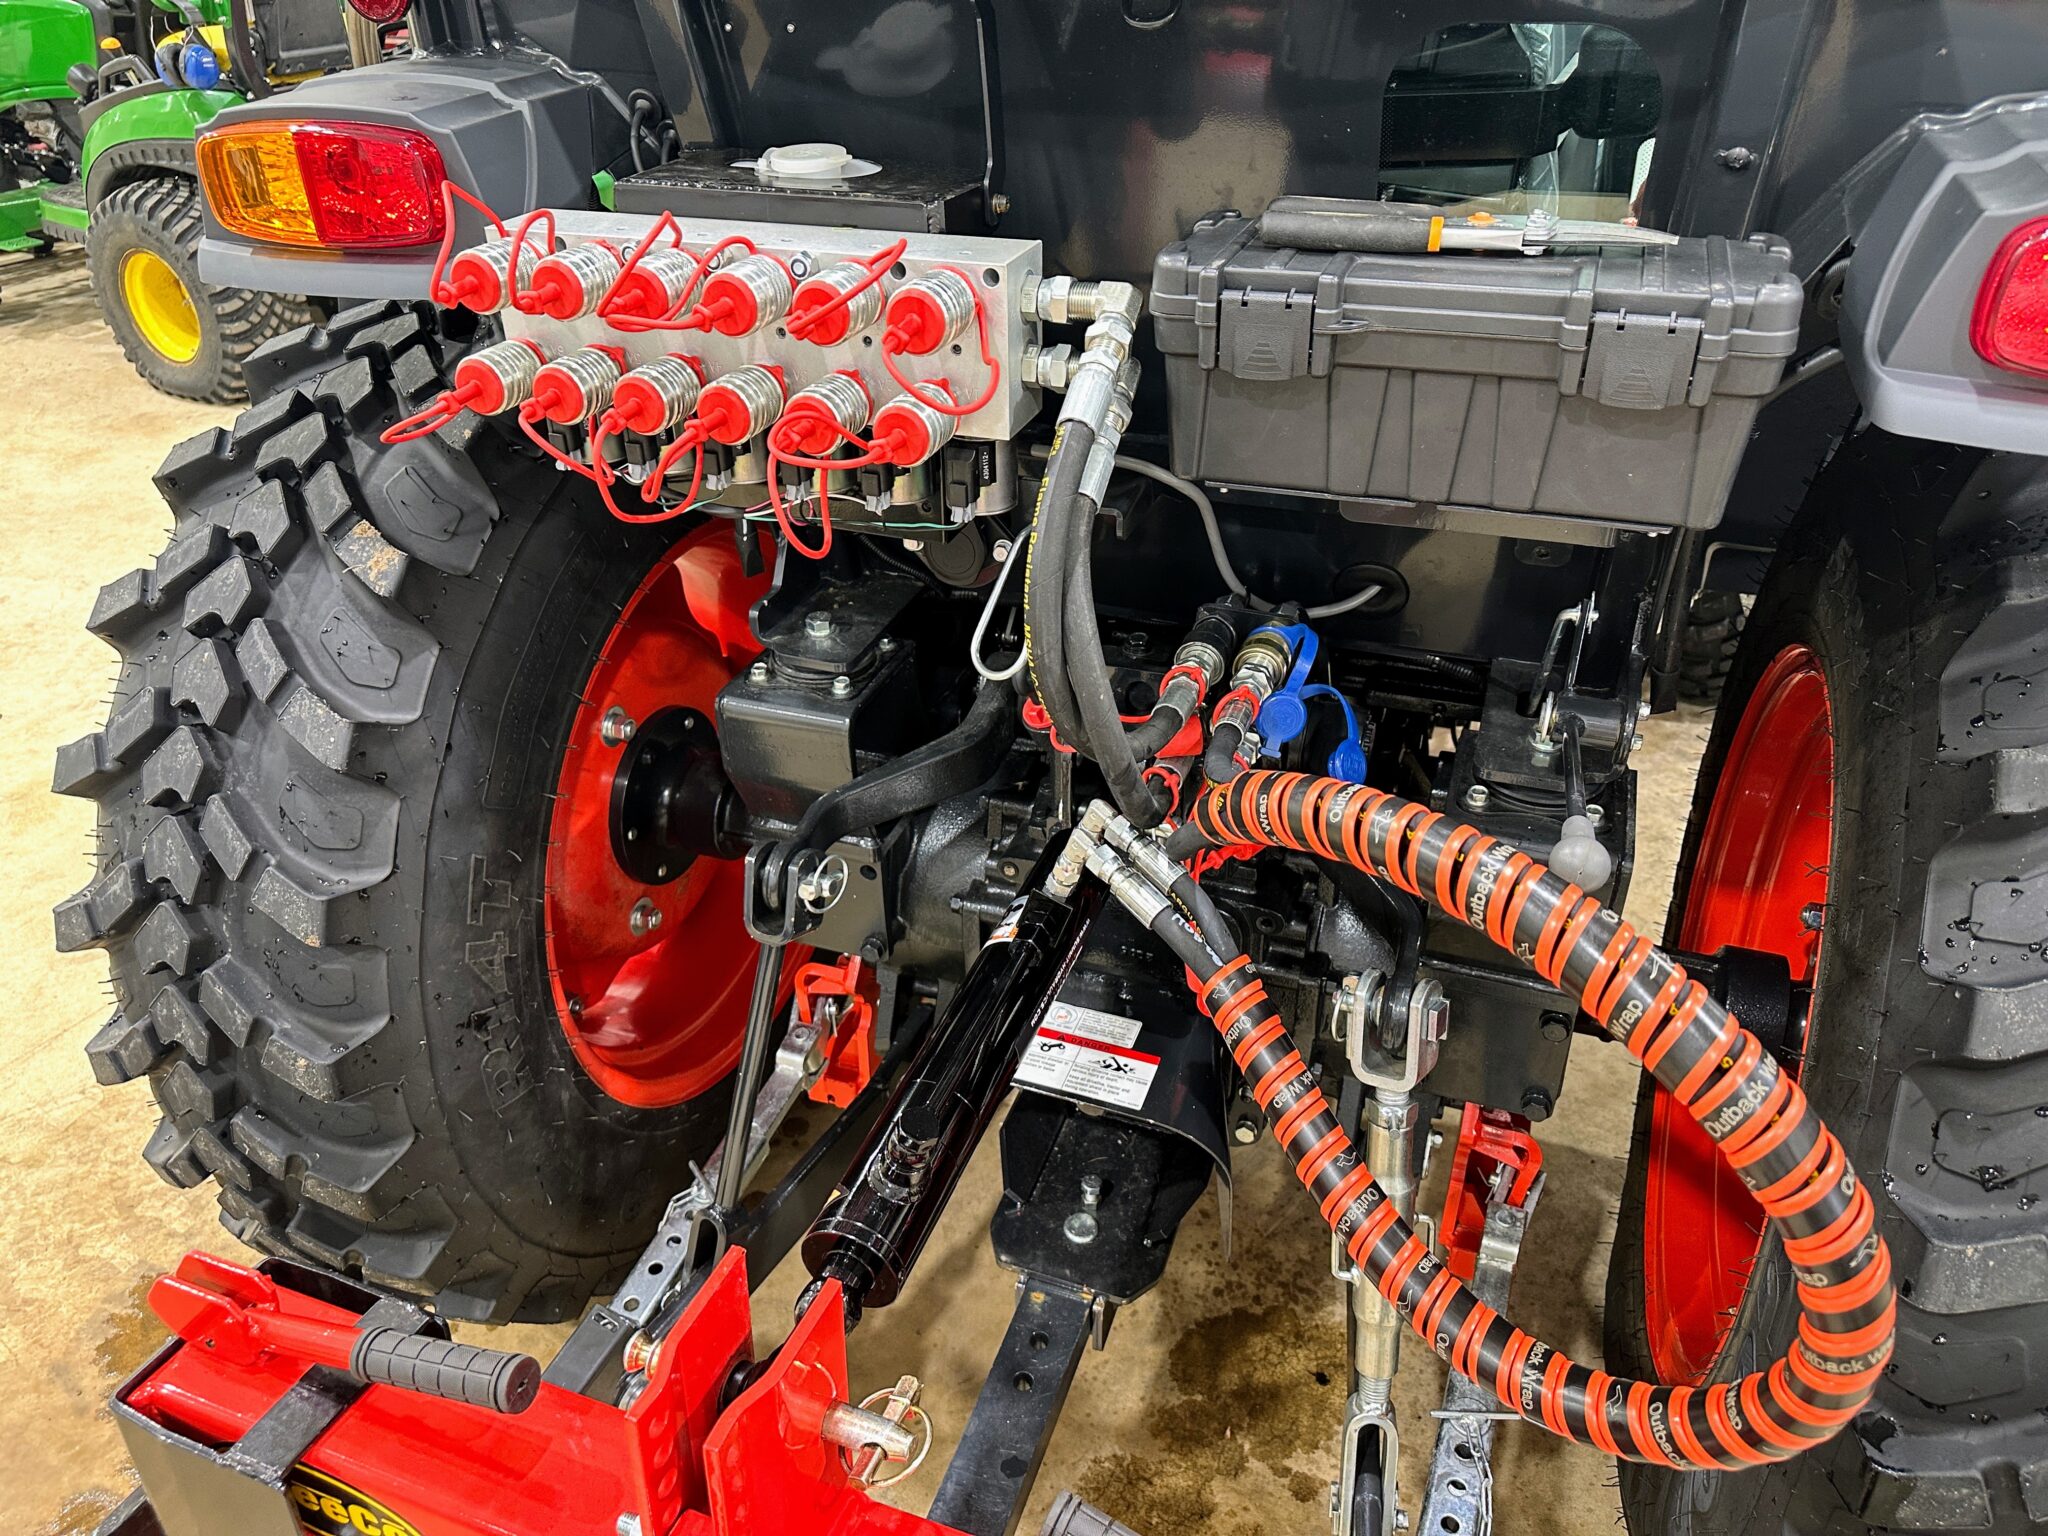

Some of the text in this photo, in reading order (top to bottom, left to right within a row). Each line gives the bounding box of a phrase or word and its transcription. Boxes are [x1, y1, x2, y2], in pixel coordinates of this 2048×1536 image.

[1032, 476, 1050, 527] Flame
[1259, 794, 1271, 833] Wrap
[1470, 862, 1498, 931] Outback
[1610, 999, 1645, 1041] Wrap
[1071, 1036, 1111, 1052] DANGER
[1273, 1081, 1304, 1109] Wrap
[1704, 1079, 1769, 1138] Outback
[1338, 1187, 1380, 1233] Outback
[1521, 1369, 1545, 1410] Wrap
